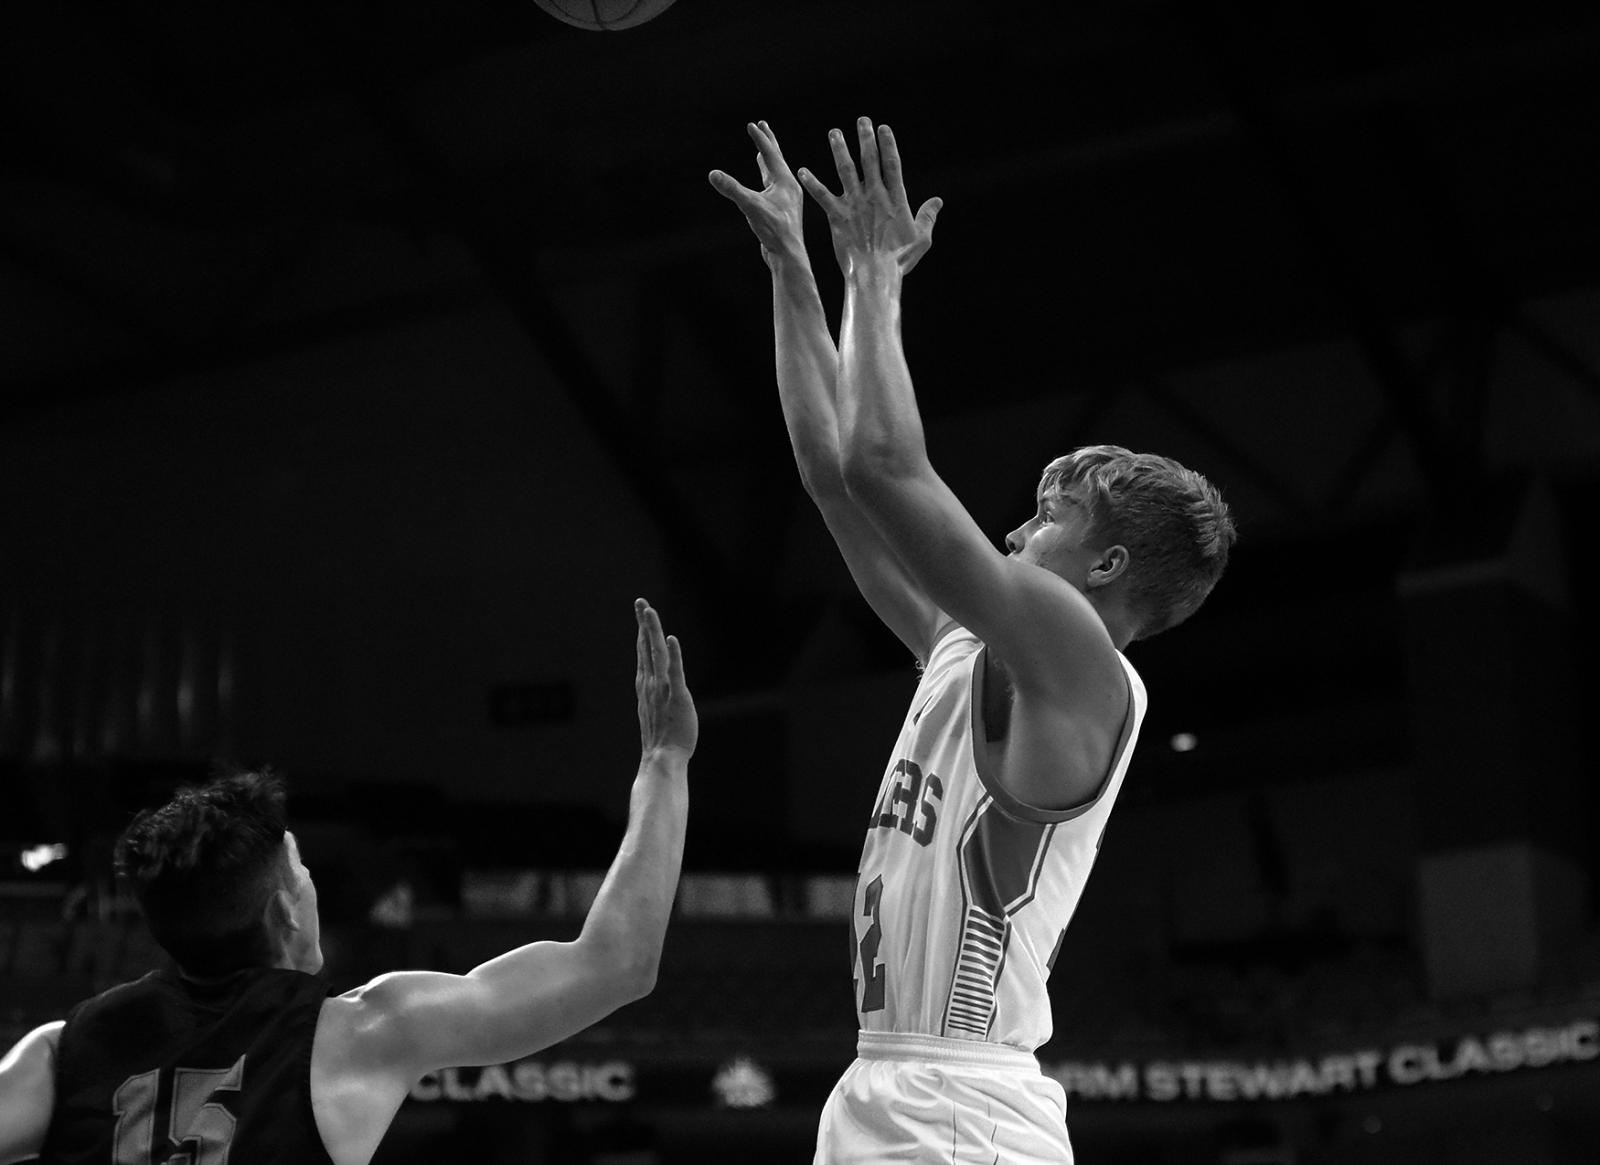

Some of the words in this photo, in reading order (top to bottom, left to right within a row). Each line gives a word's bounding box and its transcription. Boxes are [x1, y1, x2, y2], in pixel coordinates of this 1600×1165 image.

[409, 1061, 636, 1102] CLASSIC
[1042, 1059, 1138, 1101] RM
[1144, 1051, 1381, 1101] STEWART
[1388, 1021, 1600, 1086] CLASSIC
[112, 1053, 246, 1165] 15
